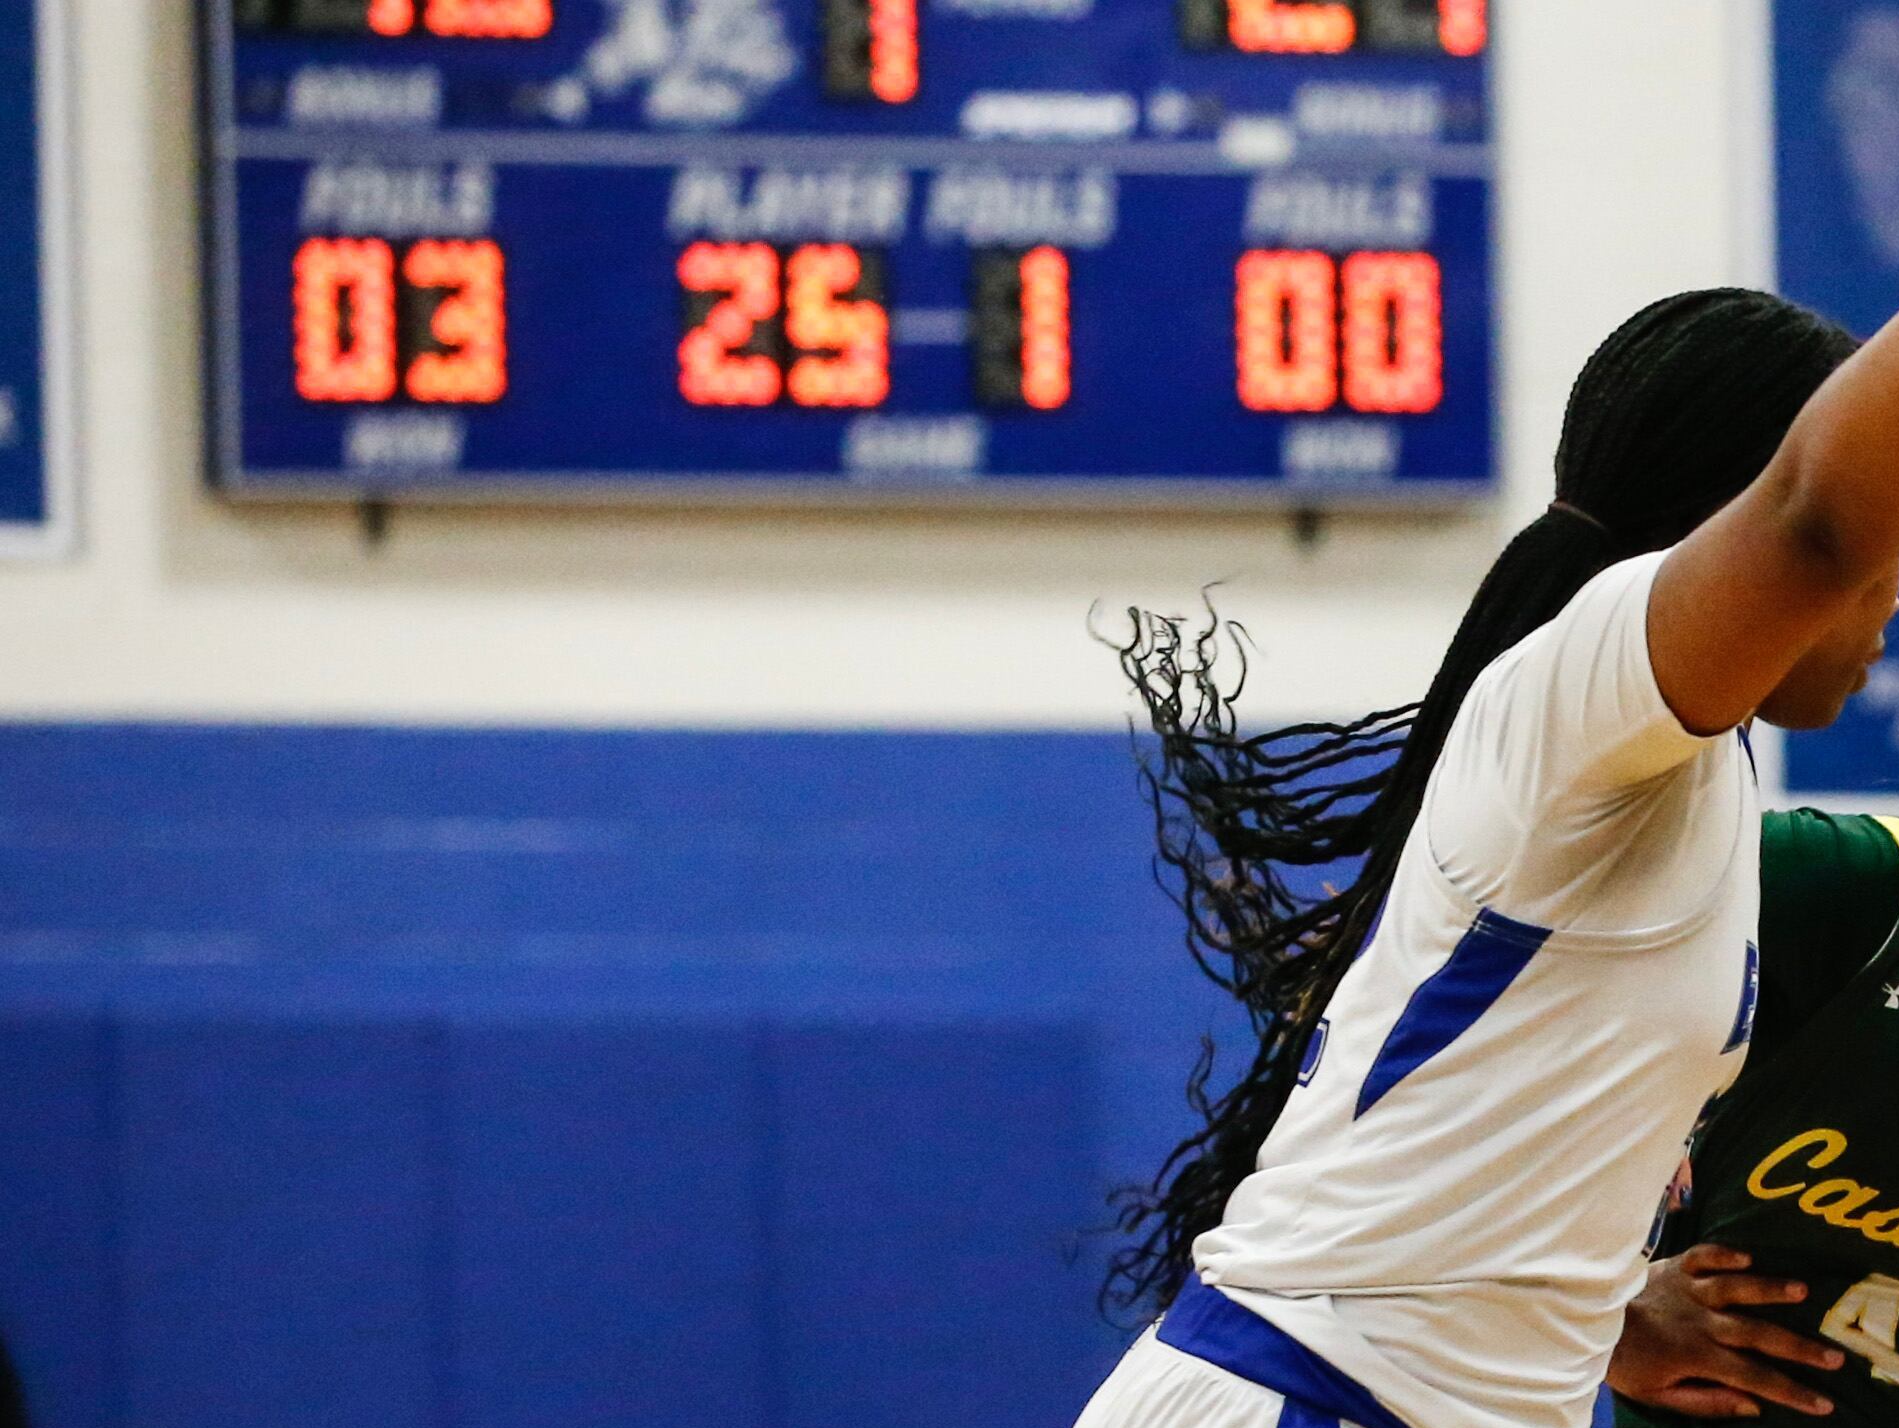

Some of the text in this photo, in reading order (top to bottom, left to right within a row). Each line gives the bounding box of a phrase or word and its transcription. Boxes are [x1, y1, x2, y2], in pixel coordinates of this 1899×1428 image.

[292, 236, 508, 403] 03
[677, 241, 890, 407] 25
[1234, 249, 1444, 413] 00
